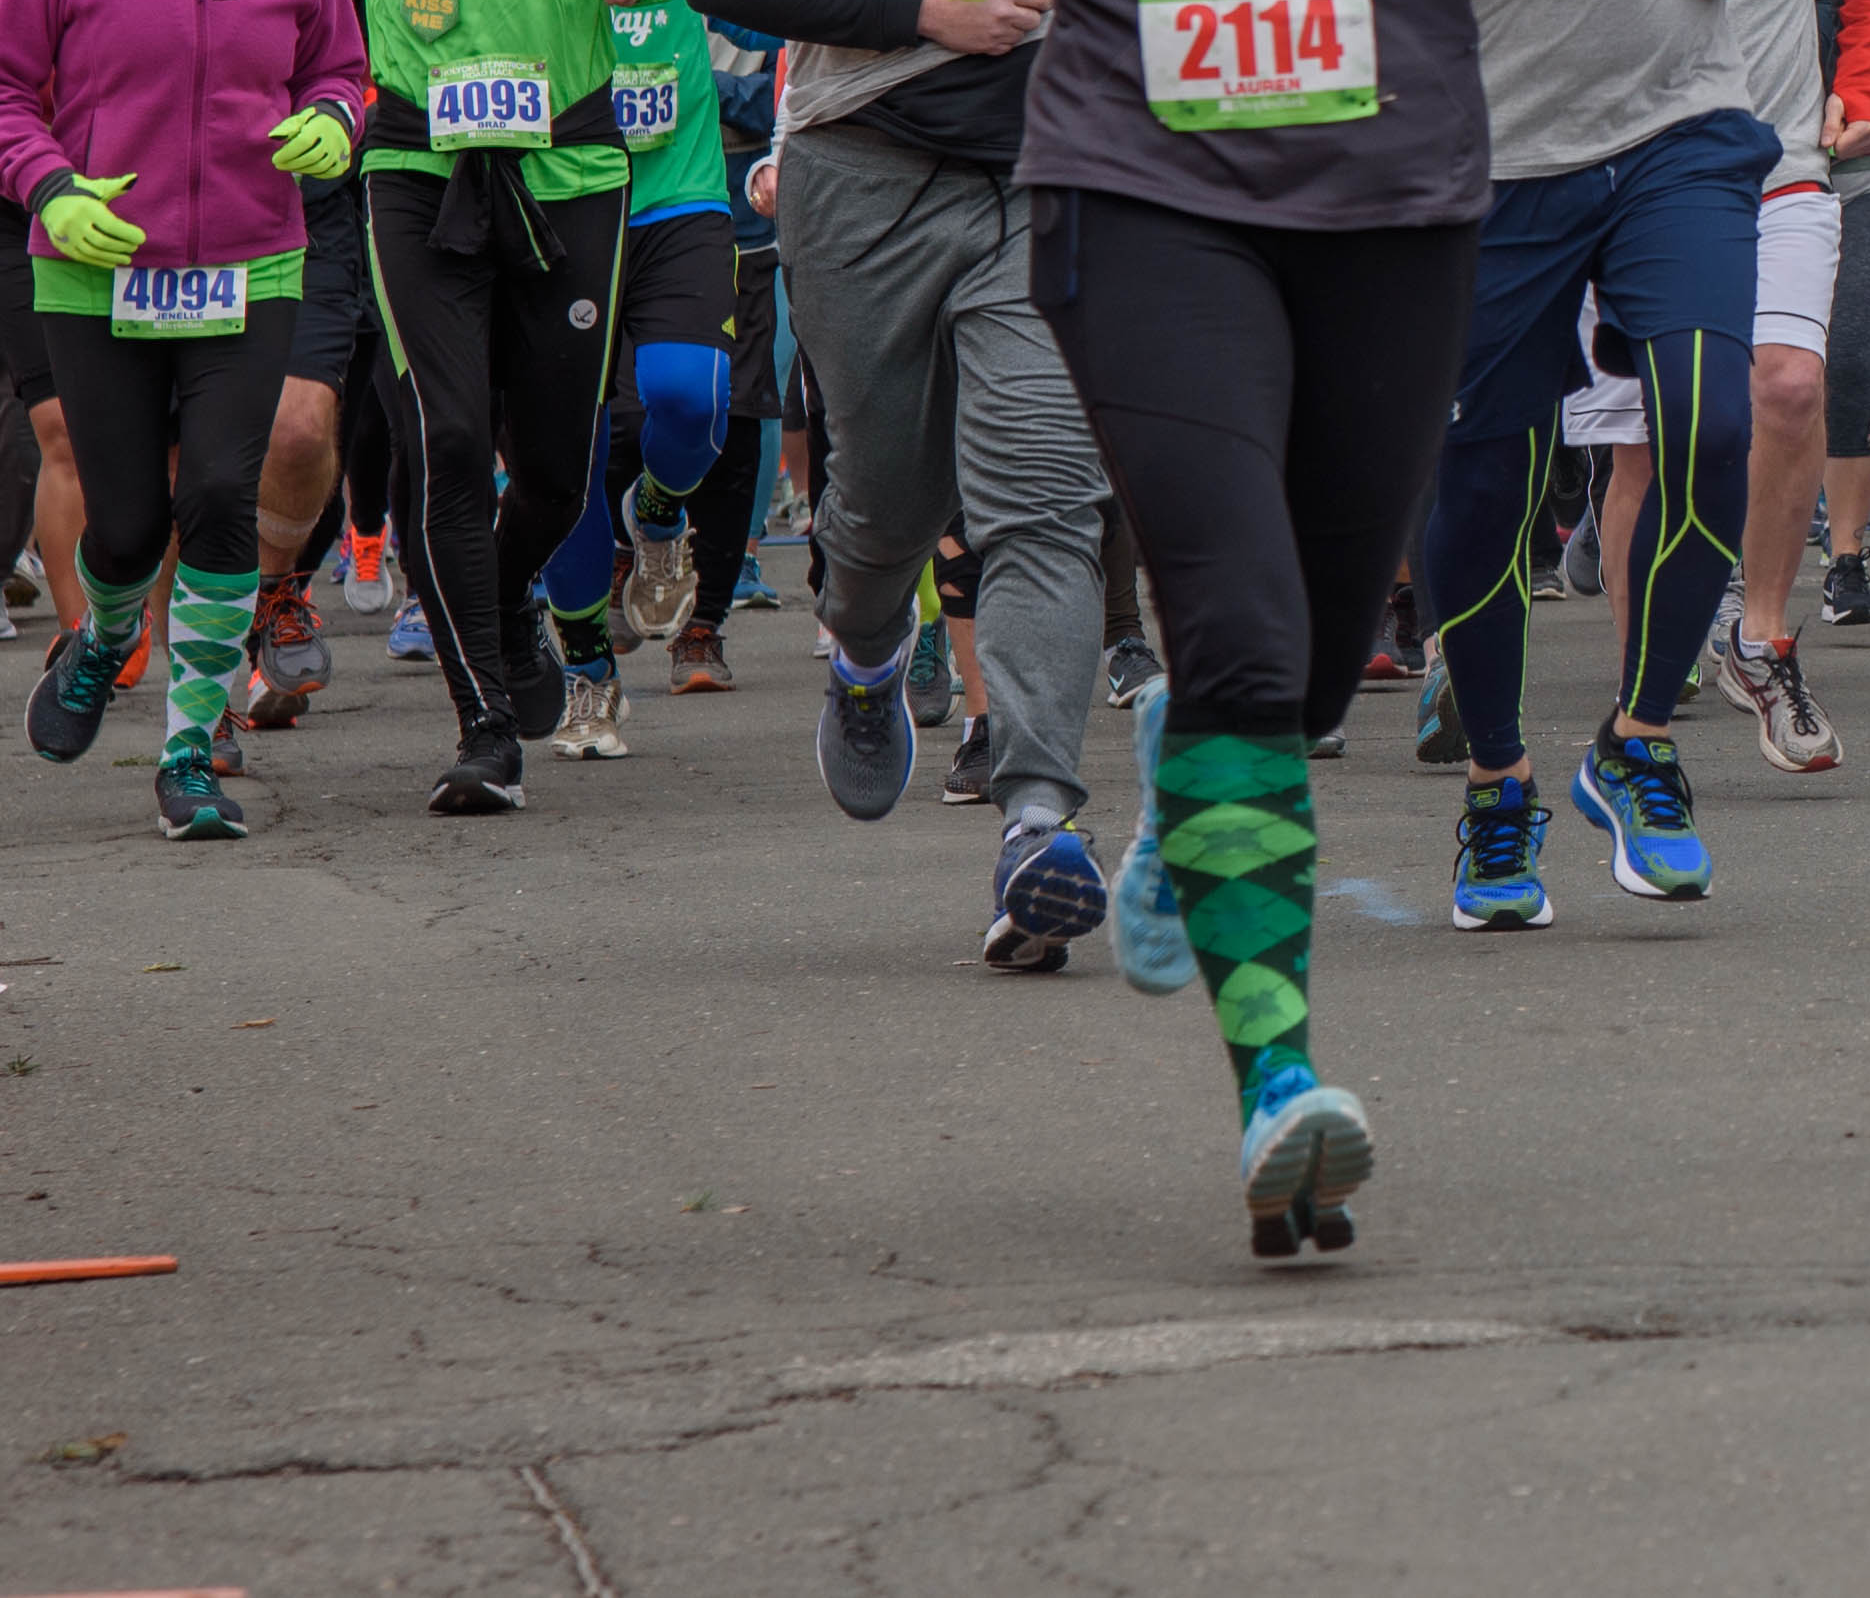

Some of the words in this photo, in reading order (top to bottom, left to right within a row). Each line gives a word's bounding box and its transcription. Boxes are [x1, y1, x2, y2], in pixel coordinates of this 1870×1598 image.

[411, 11, 444, 30] ME
[610, 5, 652, 47] ay
[436, 79, 542, 125] 4093
[1223, 78, 1302, 96] LAUREN
[613, 84, 674, 129] 633
[477, 121, 507, 130] BRAD
[122, 266, 237, 312] 4094
[154, 310, 205, 321] JENELLE
